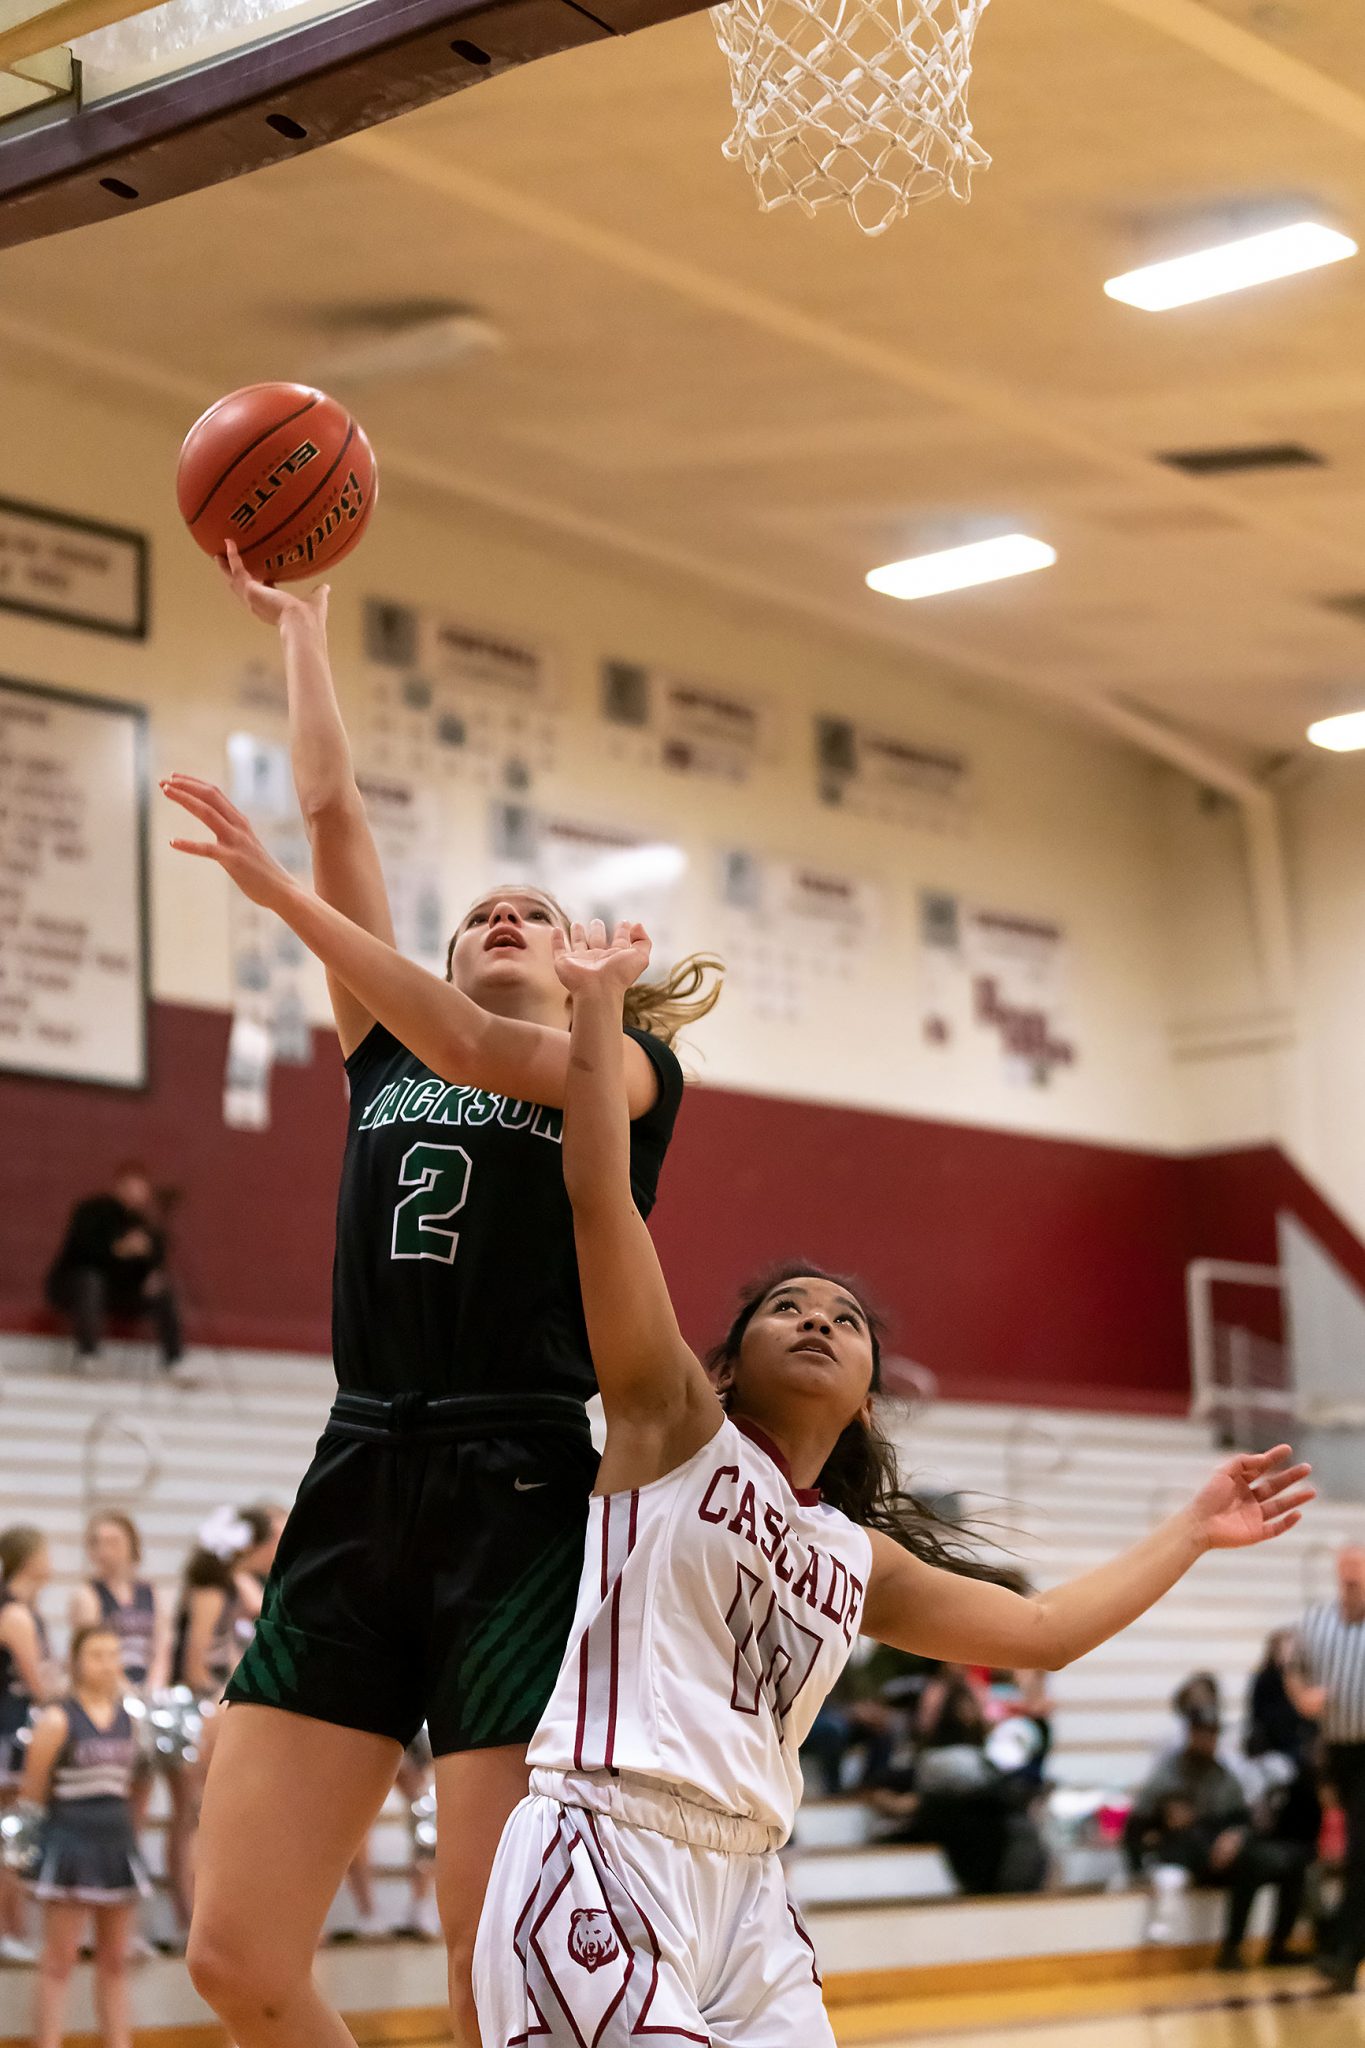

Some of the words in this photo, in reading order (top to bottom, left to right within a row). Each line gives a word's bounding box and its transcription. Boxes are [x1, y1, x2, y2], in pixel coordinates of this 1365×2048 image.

[228, 439, 320, 529] ELITE
[264, 469, 363, 570] Baden
[358, 1077, 564, 1144] JACKSON
[391, 1141, 473, 1265] 2
[698, 1465, 863, 1648] CASCADE
